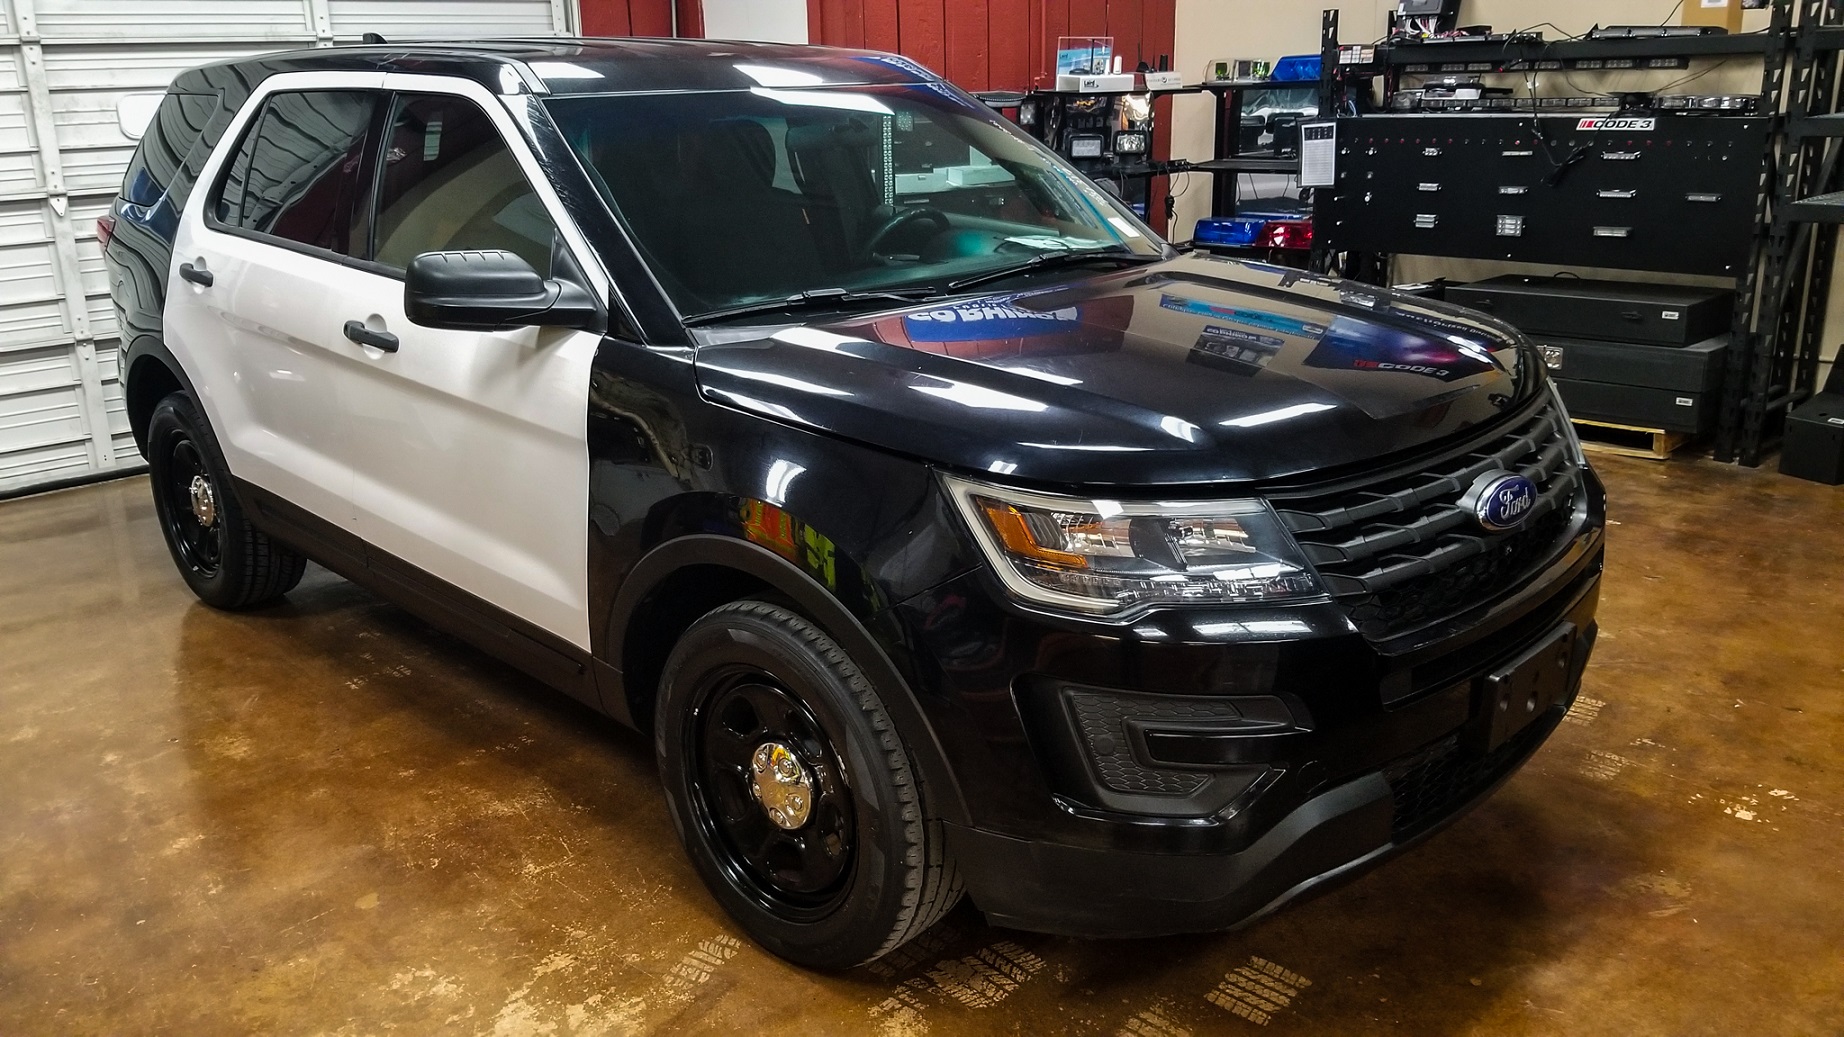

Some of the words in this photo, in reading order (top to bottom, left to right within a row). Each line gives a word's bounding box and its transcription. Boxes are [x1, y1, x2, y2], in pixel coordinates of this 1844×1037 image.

[1593, 120, 1639, 128] CODE
[1641, 120, 1652, 128] 3
[1499, 484, 1531, 521] Ford
